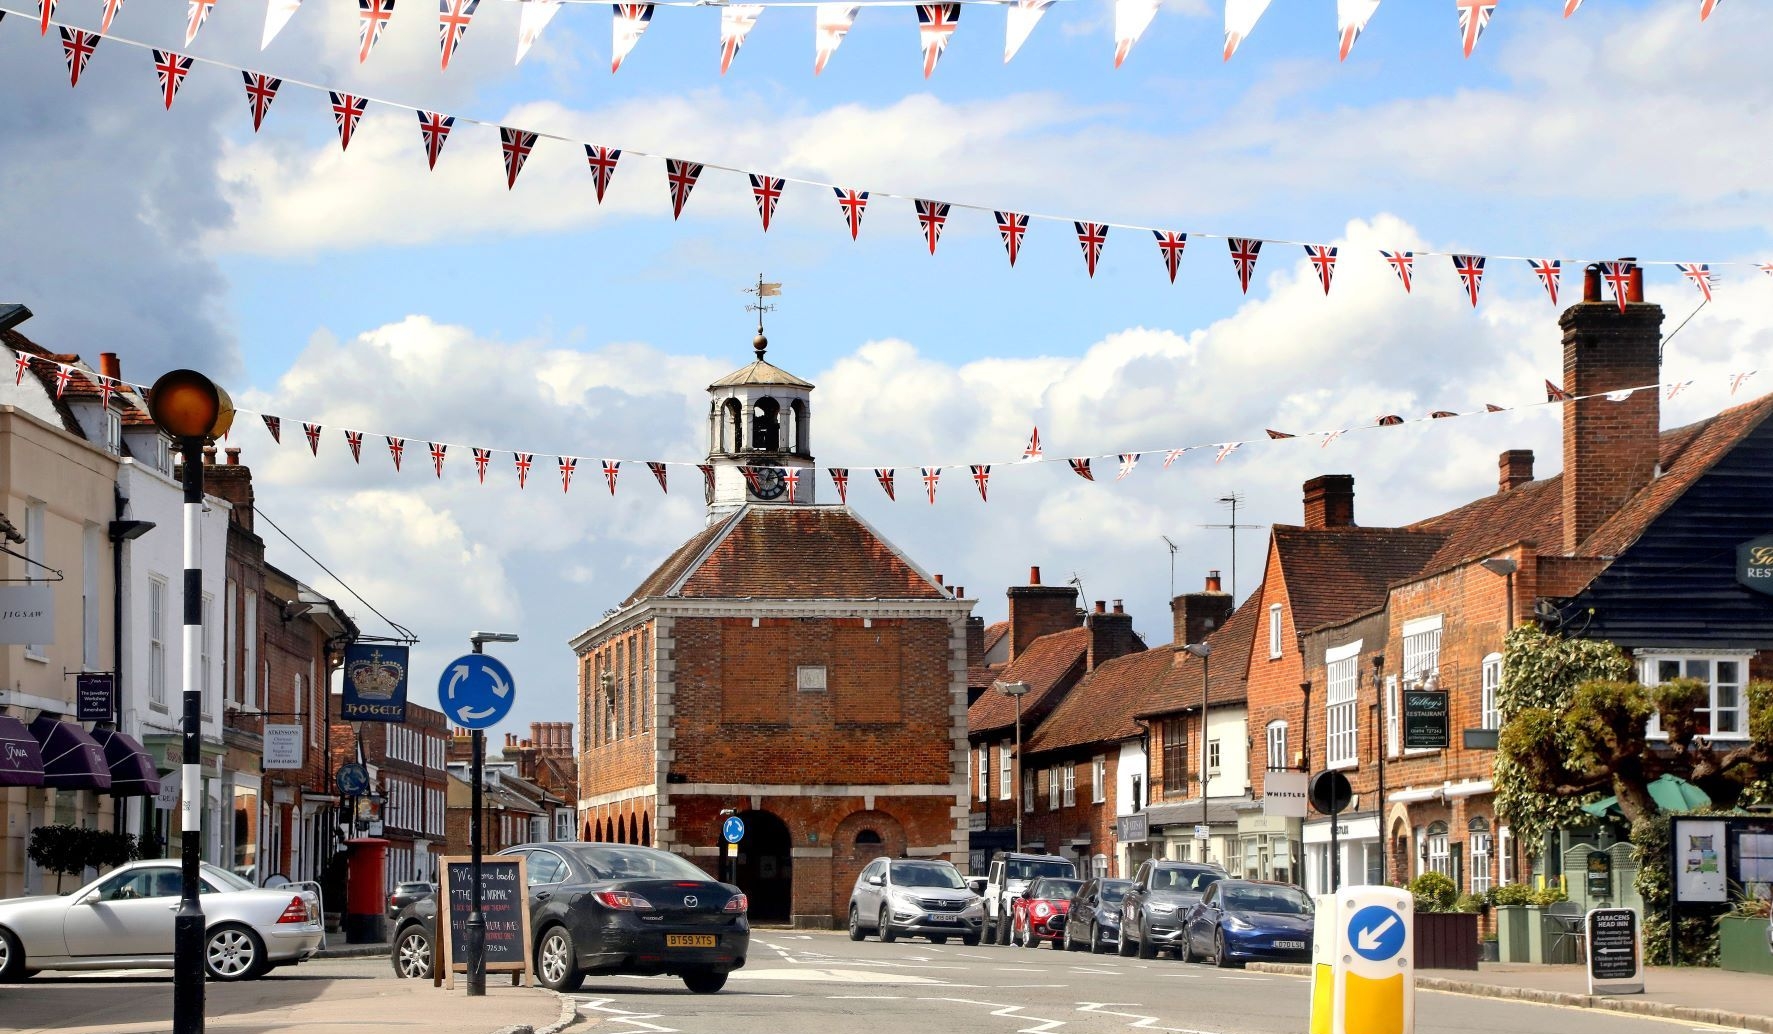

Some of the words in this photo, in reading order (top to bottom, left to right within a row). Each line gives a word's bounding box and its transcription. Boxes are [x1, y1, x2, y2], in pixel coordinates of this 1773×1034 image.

[1747, 568, 1773, 578] RES
[3, 611, 43, 619] JIGSAW
[1409, 697, 1443, 710] Gilbey's
[453, 868, 494, 882] Weome
[496, 868, 515, 880] back
[670, 936, 694, 944] BT59
[695, 936, 712, 944] XTS
